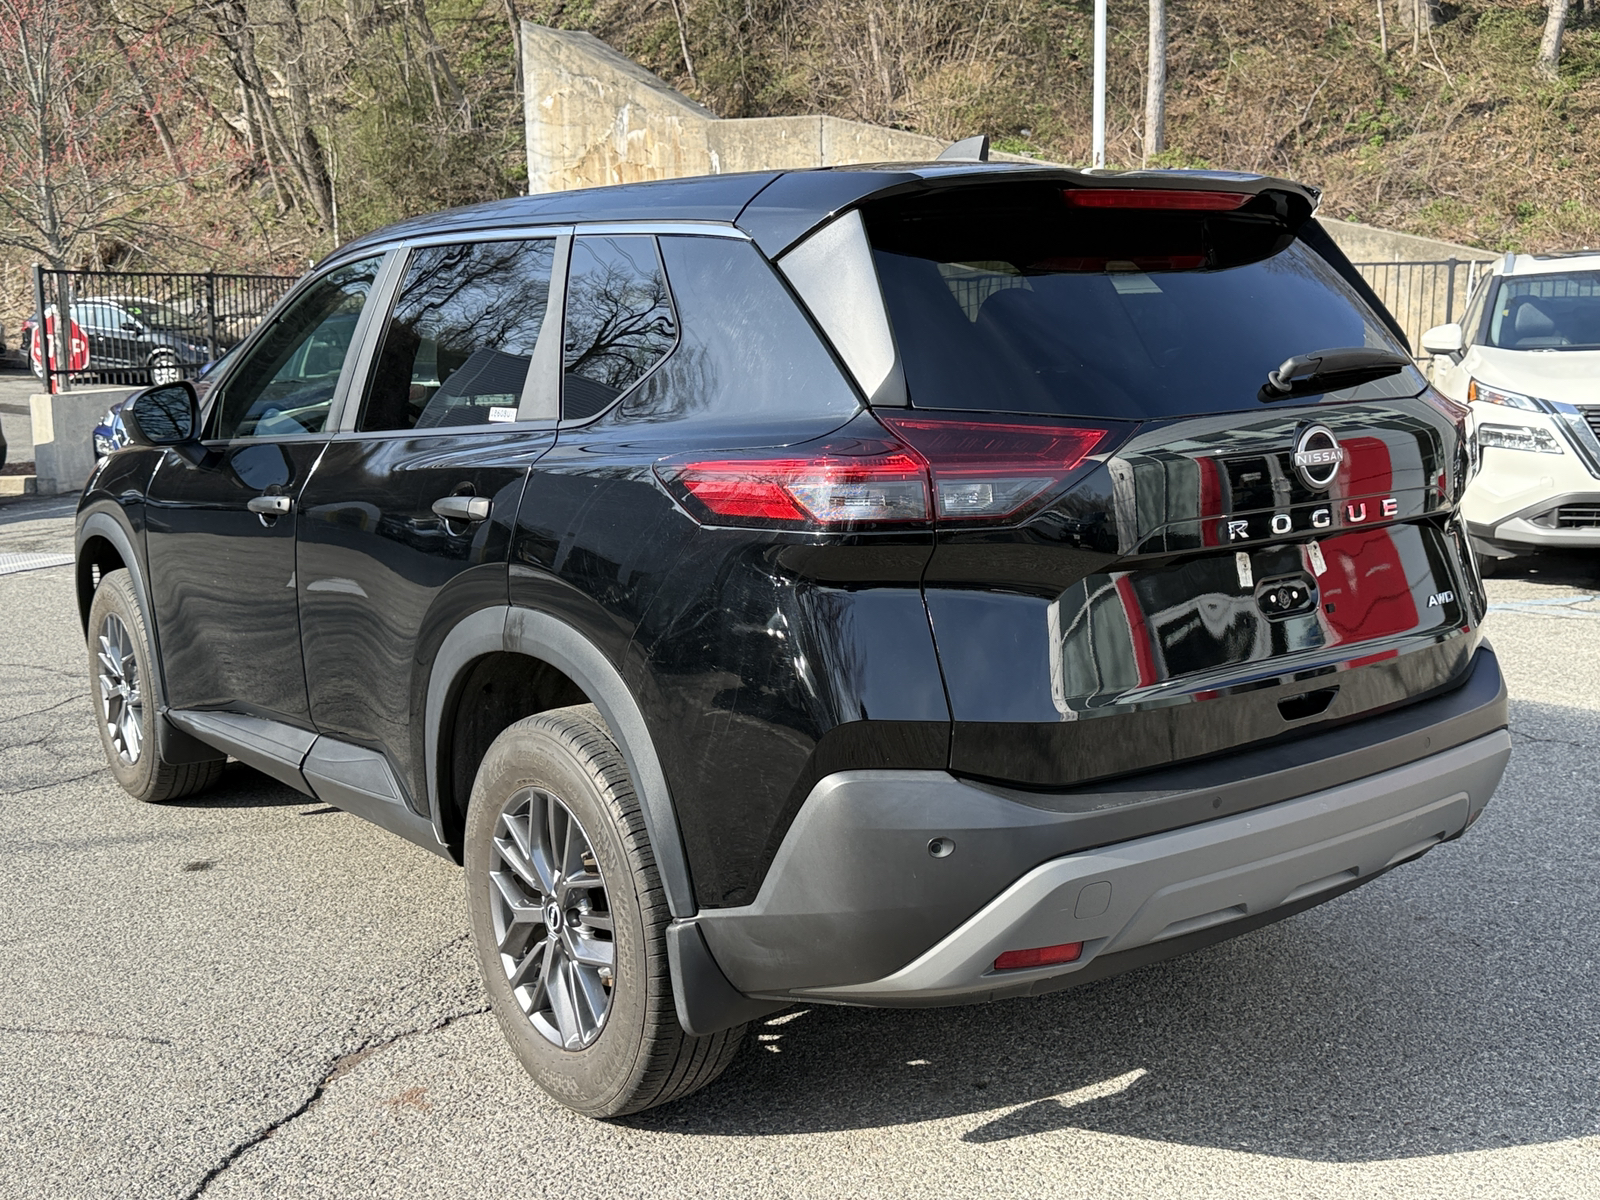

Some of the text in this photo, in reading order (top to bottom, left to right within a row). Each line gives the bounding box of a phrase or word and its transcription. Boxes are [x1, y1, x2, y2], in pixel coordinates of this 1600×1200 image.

[36, 334, 86, 358] STP
[1297, 450, 1343, 465] NISSAN
[1227, 498, 1398, 540] ROGUE
[1428, 590, 1454, 608] AWD
